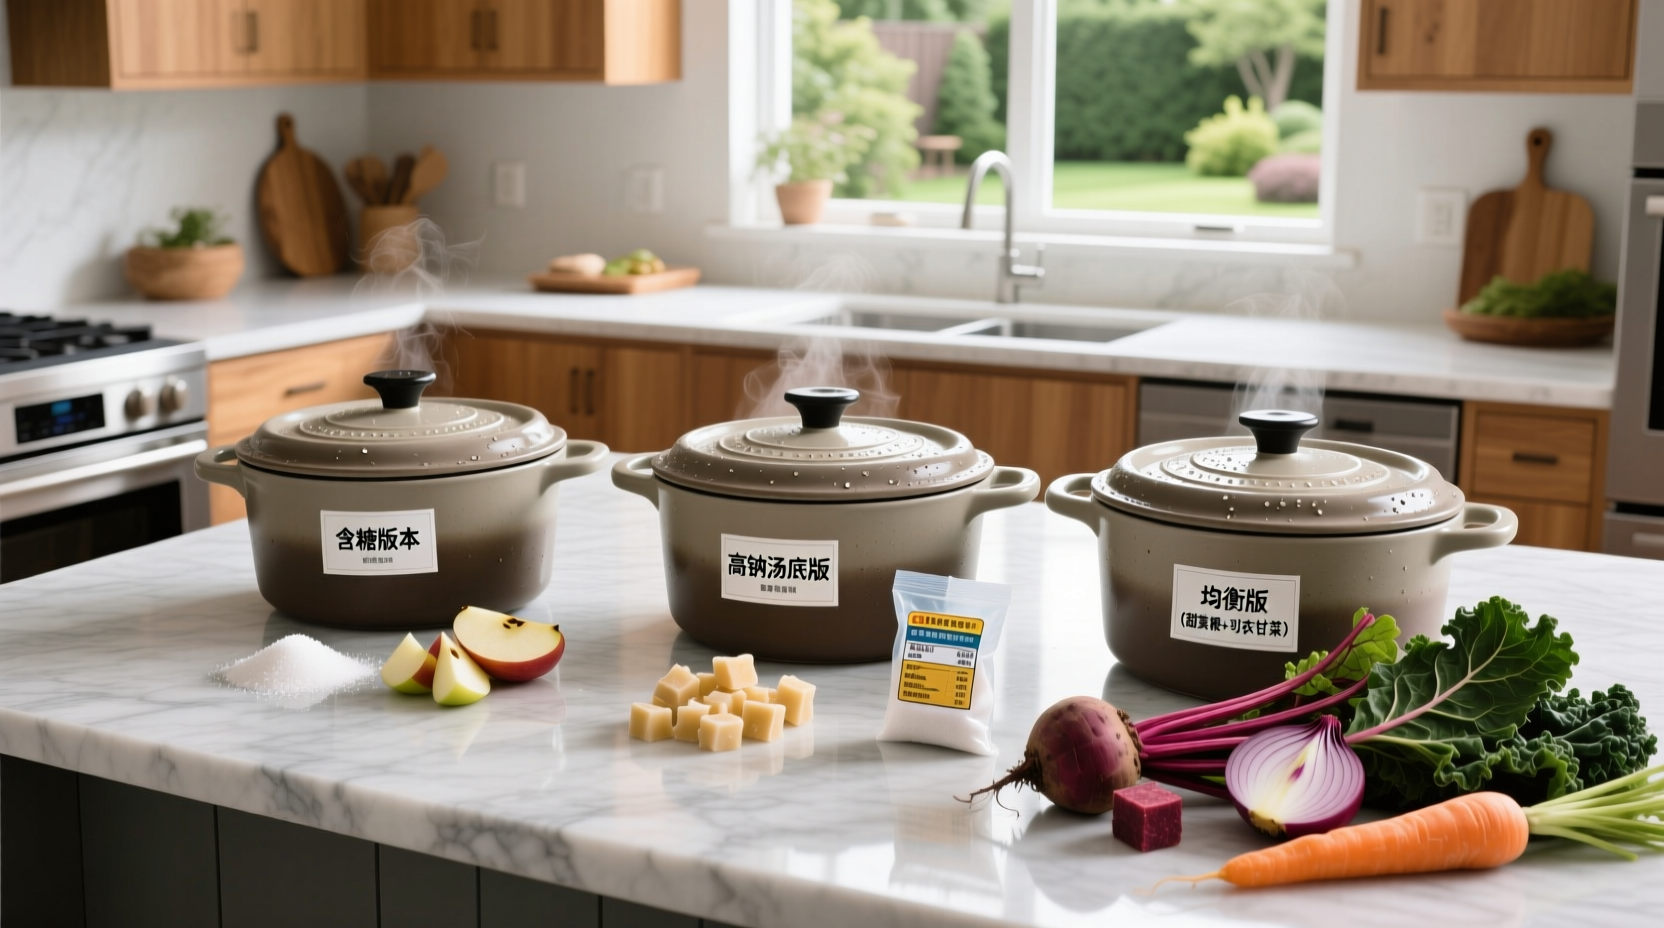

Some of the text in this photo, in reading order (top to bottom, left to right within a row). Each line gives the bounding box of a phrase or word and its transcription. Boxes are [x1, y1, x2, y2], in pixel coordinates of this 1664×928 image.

[335, 527, 420, 551] 含糖版本
[728, 552, 830, 581] 高钠汤底版
[1200, 585, 1268, 613] 均衡版
